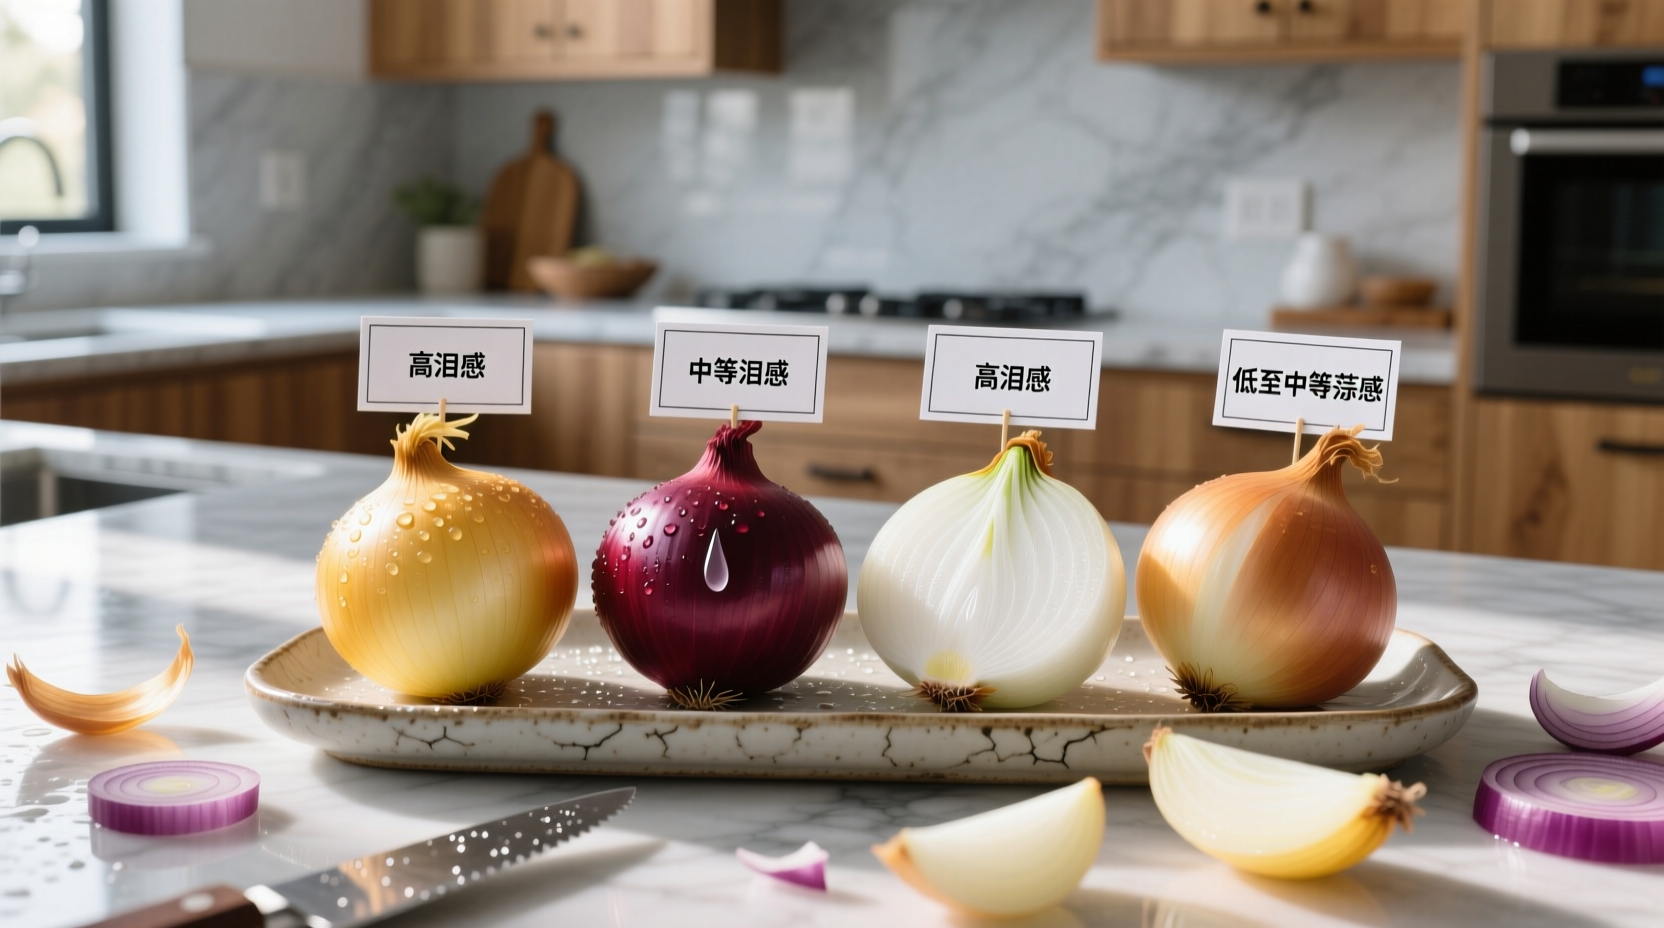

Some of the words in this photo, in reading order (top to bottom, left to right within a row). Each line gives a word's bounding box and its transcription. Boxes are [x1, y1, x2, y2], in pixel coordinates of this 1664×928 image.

[409, 351, 486, 379] 高泪感
[689, 357, 789, 387] 中等泪感
[975, 362, 1052, 392] 高泪感
